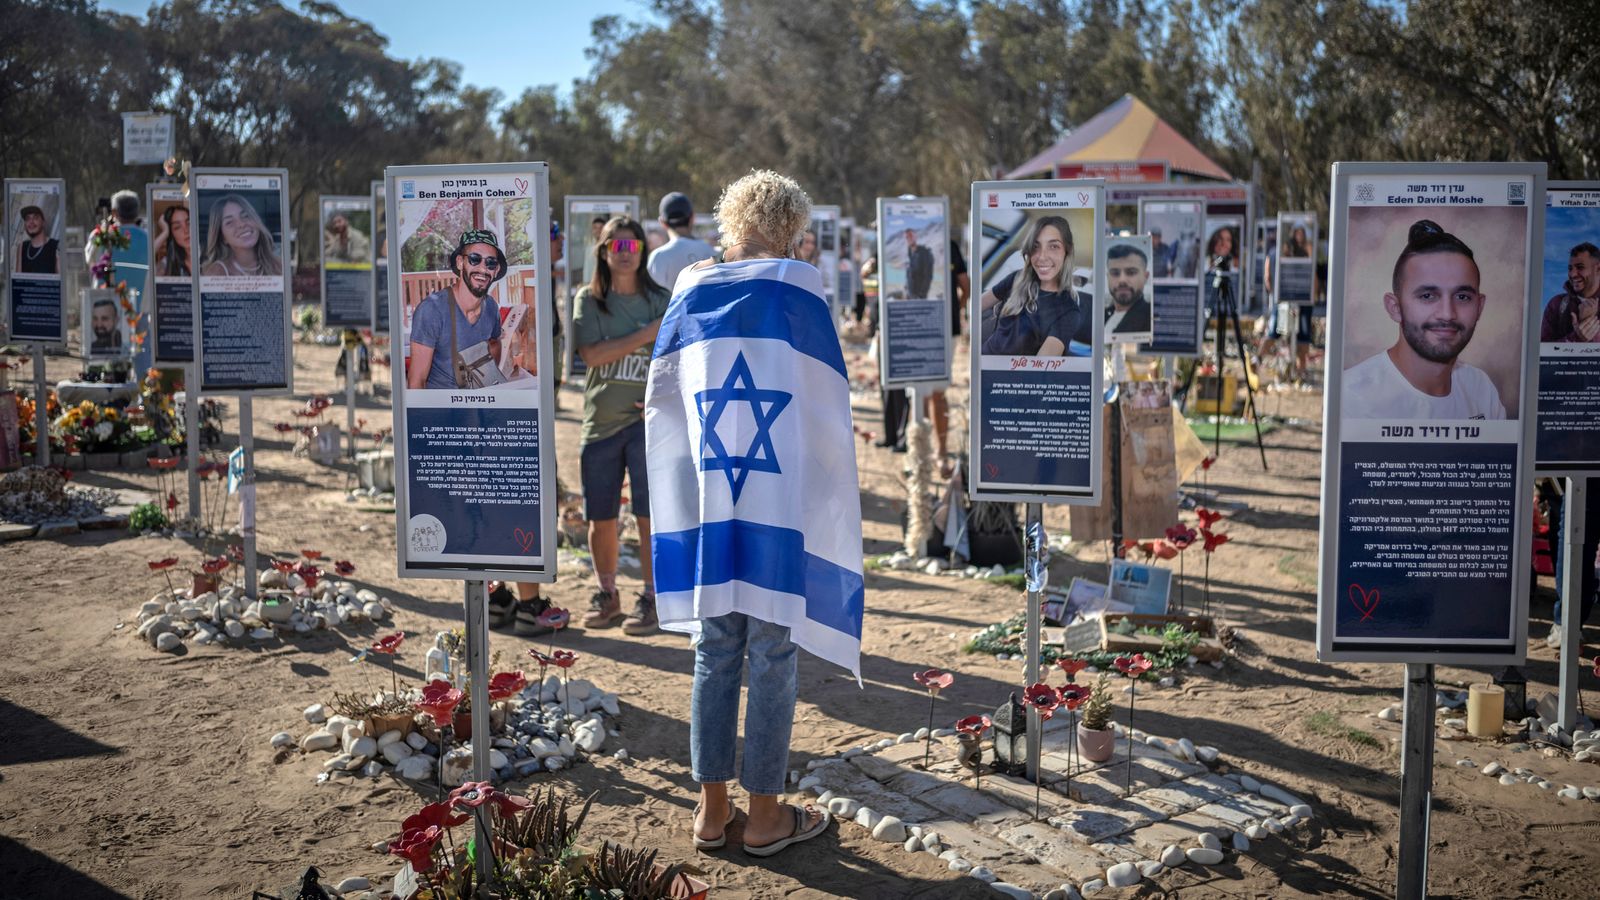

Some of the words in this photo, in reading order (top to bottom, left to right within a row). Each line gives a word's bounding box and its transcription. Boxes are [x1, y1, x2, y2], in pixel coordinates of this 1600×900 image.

[1449, 185, 1464, 193] עדן
[440, 190, 483, 199] Benjamin
[1031, 360, 1044, 368] אור
[1382, 426, 1414, 437] משה
[1419, 426, 1450, 437] דויד
[1455, 427, 1480, 439] עדן
